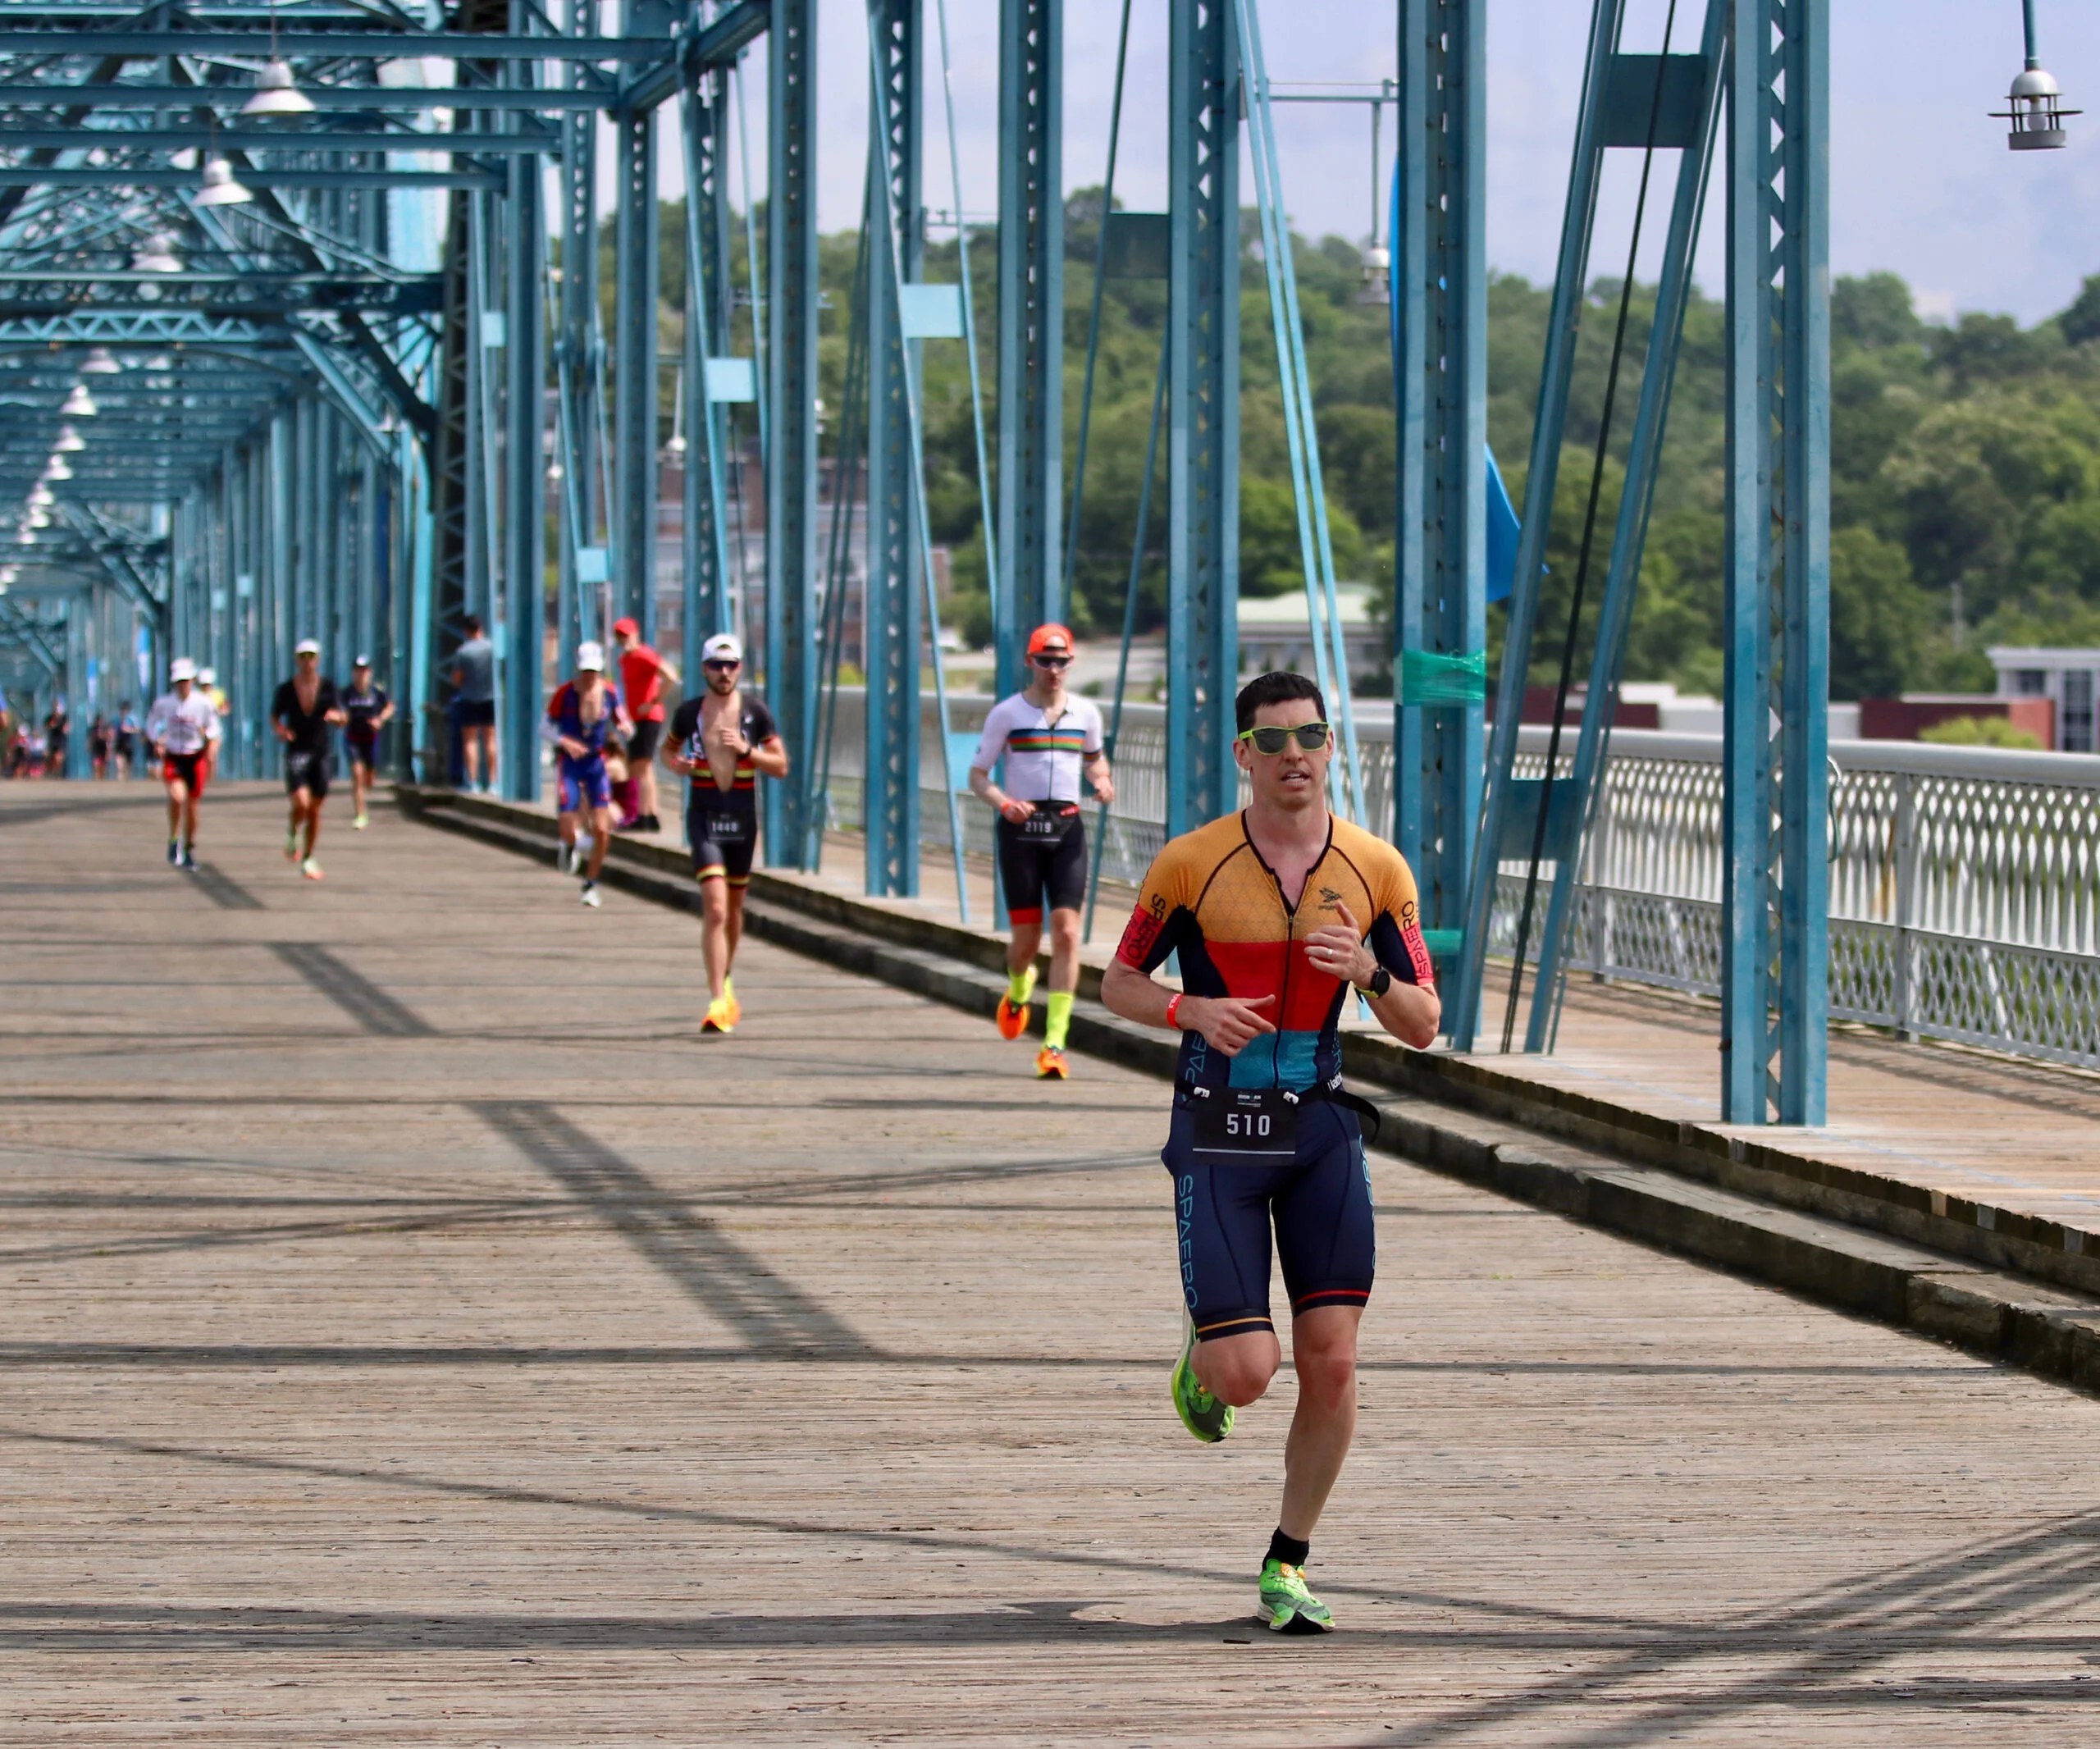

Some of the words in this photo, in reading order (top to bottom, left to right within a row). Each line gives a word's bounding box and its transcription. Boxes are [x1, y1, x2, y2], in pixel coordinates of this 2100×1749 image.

[1127, 893, 1166, 959] SPAERO
[1402, 901, 1427, 975] SPAERO
[1227, 1113, 1270, 1135] 510
[1179, 1175, 1198, 1309] SPAERO
